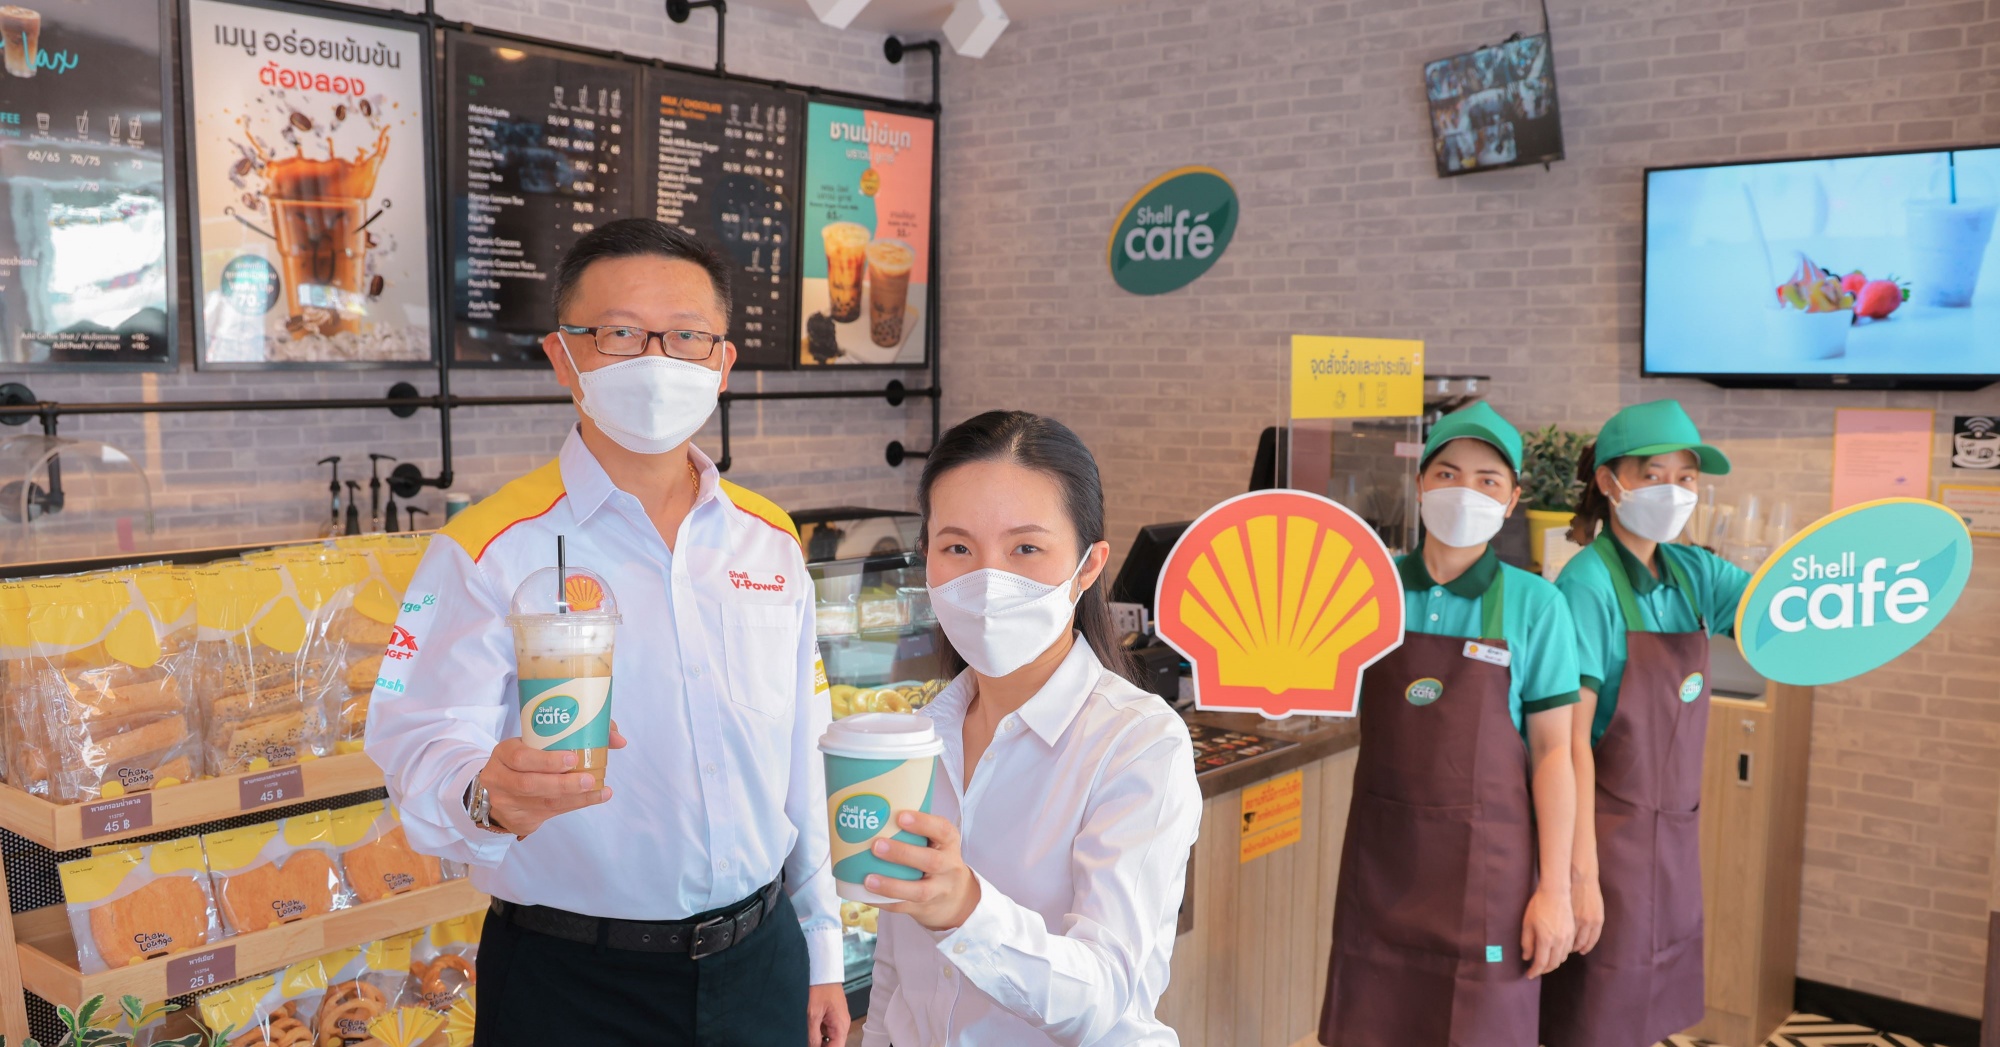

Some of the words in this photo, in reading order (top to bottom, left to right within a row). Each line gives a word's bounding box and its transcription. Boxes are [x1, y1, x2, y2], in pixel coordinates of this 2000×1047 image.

[215, 24, 256, 57] เมนู
[264, 29, 400, 69] อร่อยเข้มข้น
[259, 61, 365, 96] ต้องลอง
[830, 121, 911, 153] ชานมไข่มุก
[27, 150, 60, 163] 60/65
[70, 153, 101, 167] 70/75
[131, 159, 143, 170] 75
[1137, 204, 1173, 225] Shell
[1124, 209, 1215, 261] café
[1792, 552, 1855, 581] Shell
[729, 570, 749, 579] Shell
[731, 579, 784, 592] V-Power
[1769, 557, 1929, 632] café
[536, 708, 570, 725] café
[266, 746, 293, 755] Chew
[268, 751, 296, 762] Lounge
[118, 768, 149, 778] Chew
[122, 774, 154, 787] Lounge
[260, 790, 273, 802] 45
[91, 798, 141, 813] พายกรอบน้ำตาล
[842, 805, 859, 814] Shell
[839, 809, 880, 829] café
[104, 821, 120, 832] 45
[383, 873, 410, 883] Chew
[388, 876, 415, 890] Lounge
[272, 900, 300, 911] Chew
[277, 904, 307, 918] Lounge
[134, 932, 165, 944] Chew
[139, 937, 173, 952] Lounge
[190, 976, 205, 989] 25
[342, 1025, 368, 1035] Loung
